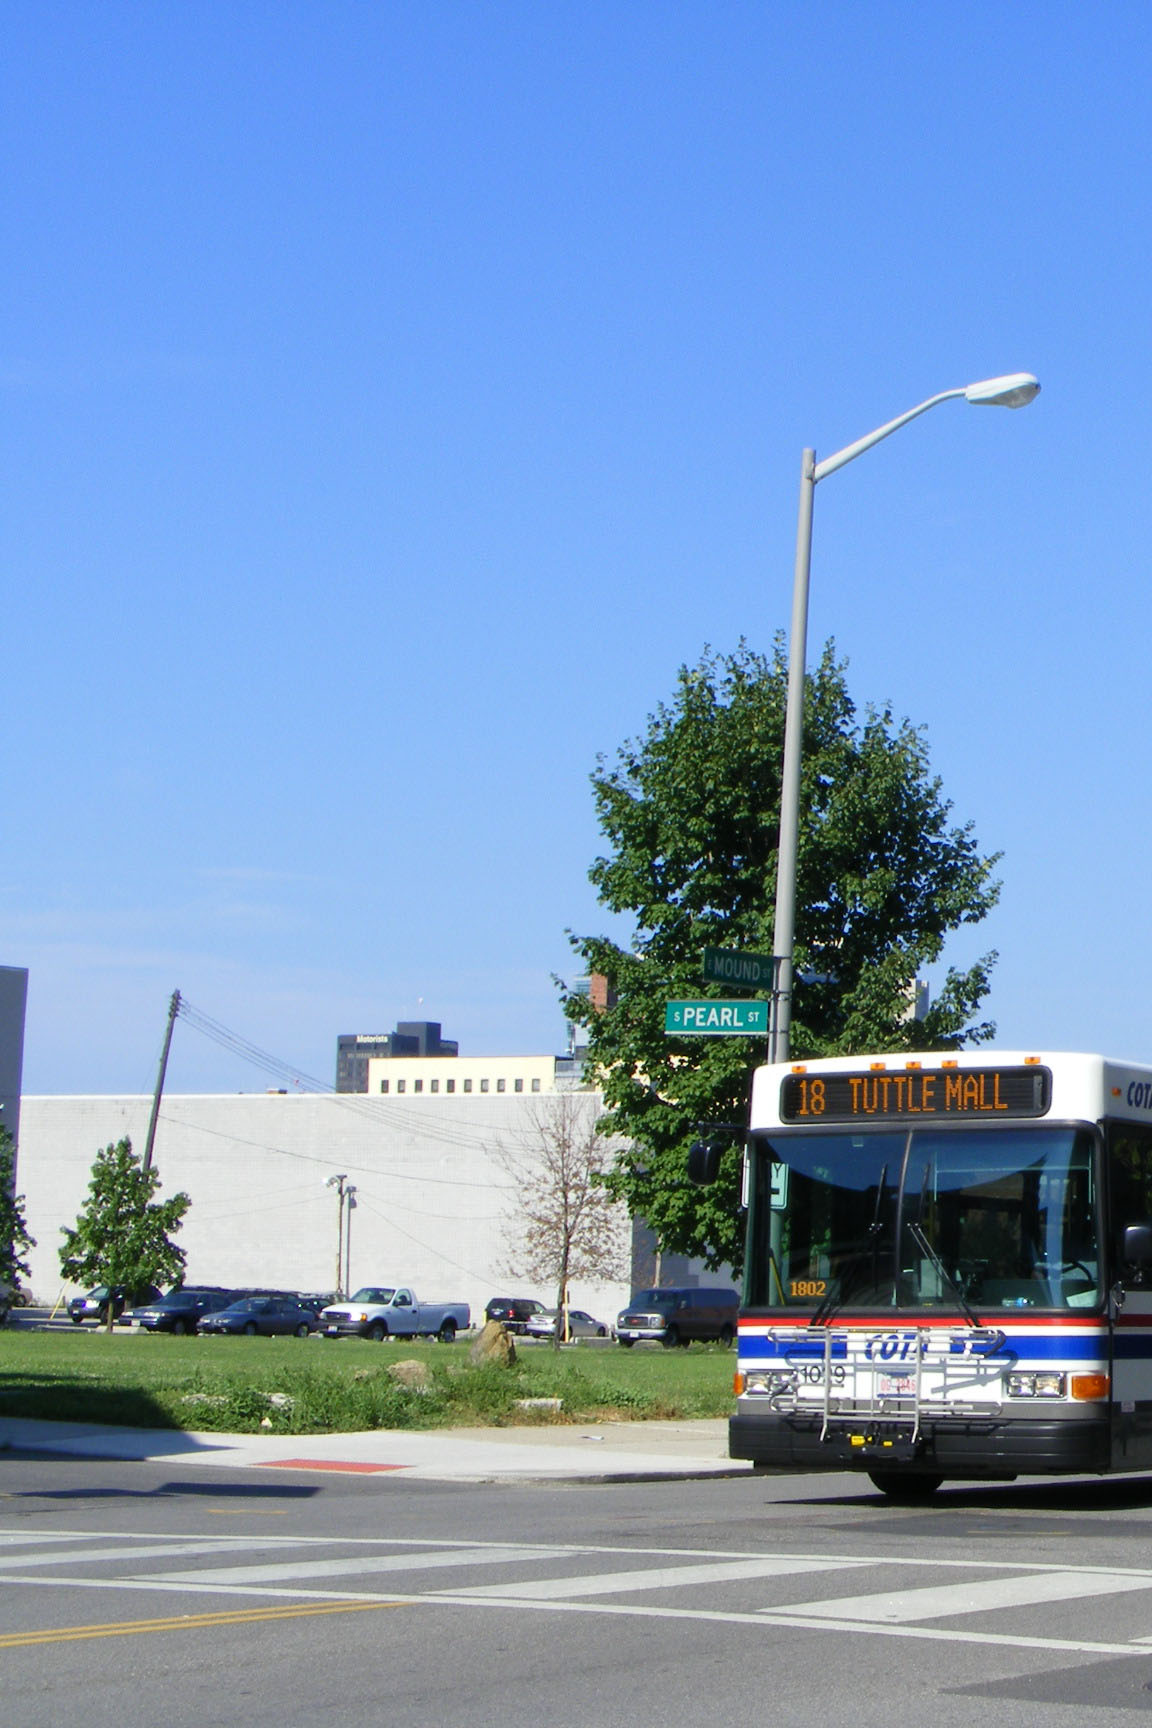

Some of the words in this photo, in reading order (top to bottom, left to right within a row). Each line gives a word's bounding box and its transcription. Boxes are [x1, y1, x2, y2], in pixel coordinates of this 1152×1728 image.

[714, 956, 761, 981] MOUND
[673, 1011, 681, 1022] S
[683, 1007, 744, 1027] PEARL
[747, 1011, 760, 1023] ST
[799, 1079, 825, 1115] 18
[848, 1075, 936, 1113] TUTTLE
[945, 1073, 1008, 1111] MALL
[791, 1280, 826, 1296] 1802
[802, 1365, 846, 1384] 109
